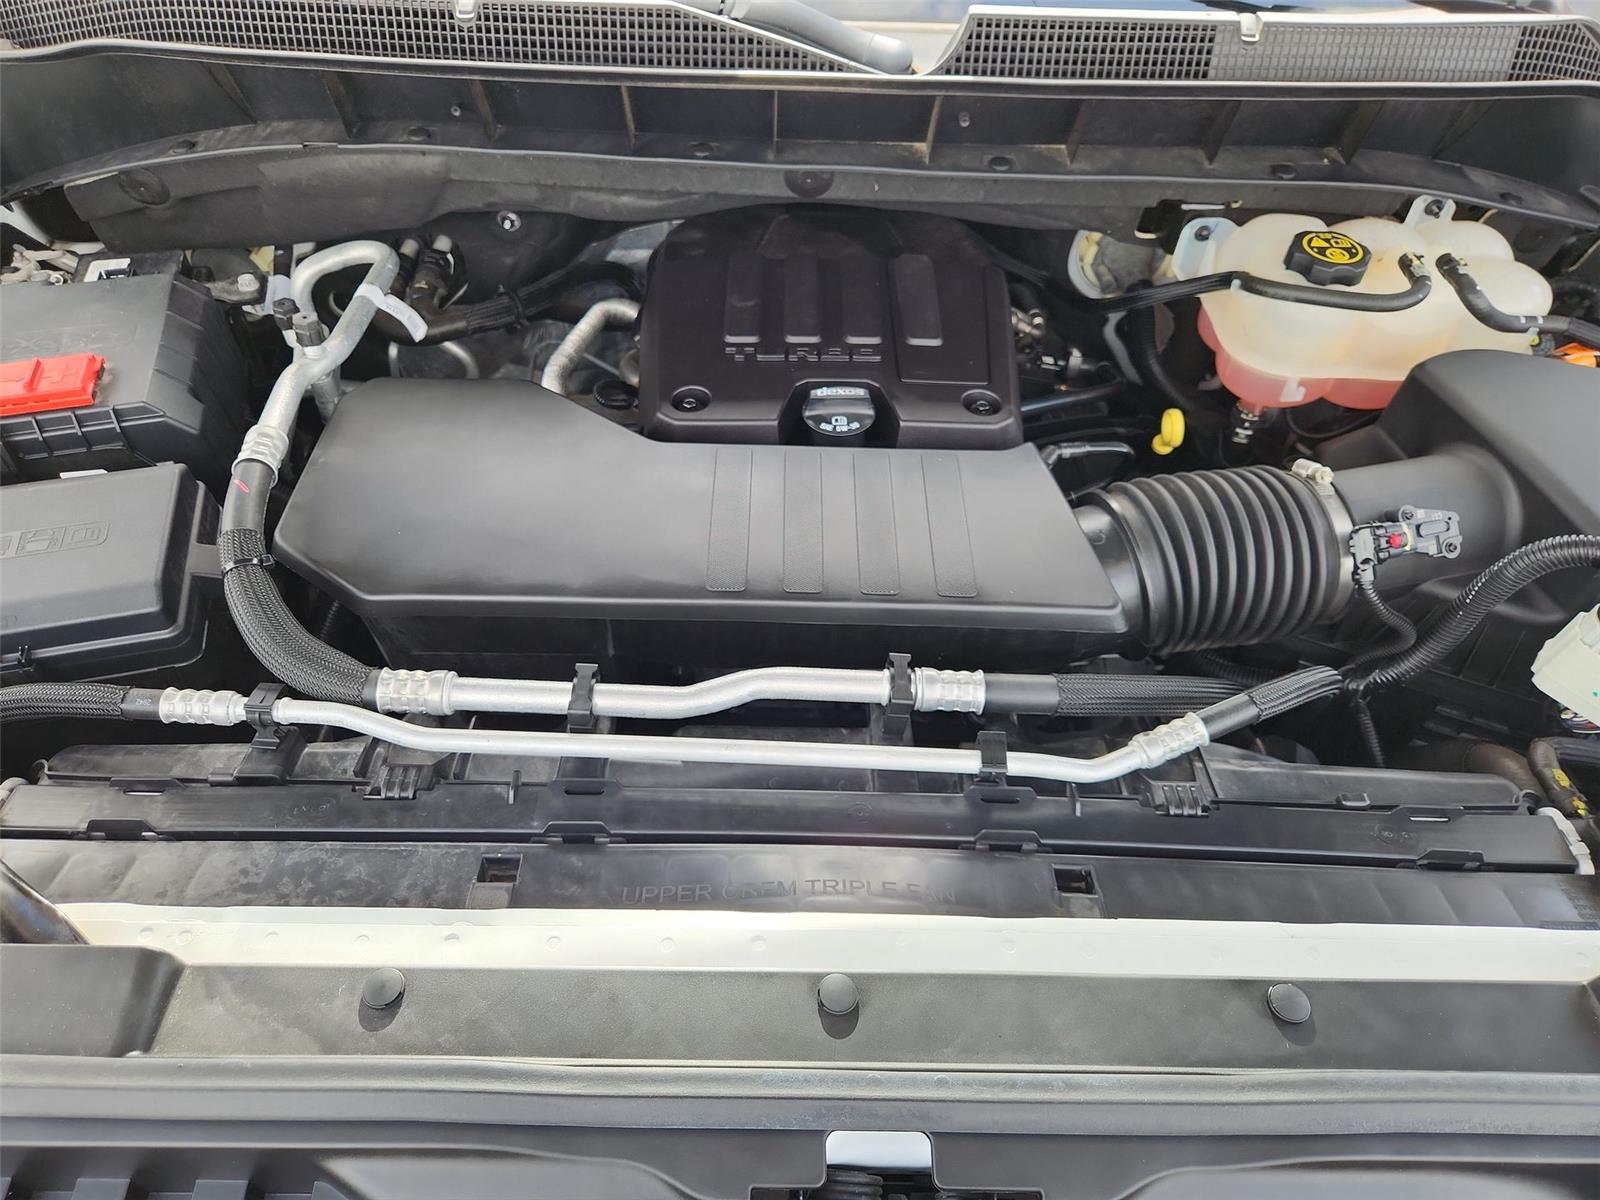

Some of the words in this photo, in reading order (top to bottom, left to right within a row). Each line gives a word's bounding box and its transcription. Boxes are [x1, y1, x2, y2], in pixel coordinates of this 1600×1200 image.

[816, 386, 865, 397] dexos
[622, 884, 713, 905] UPPER
[804, 879, 897, 898] TRIPLE
